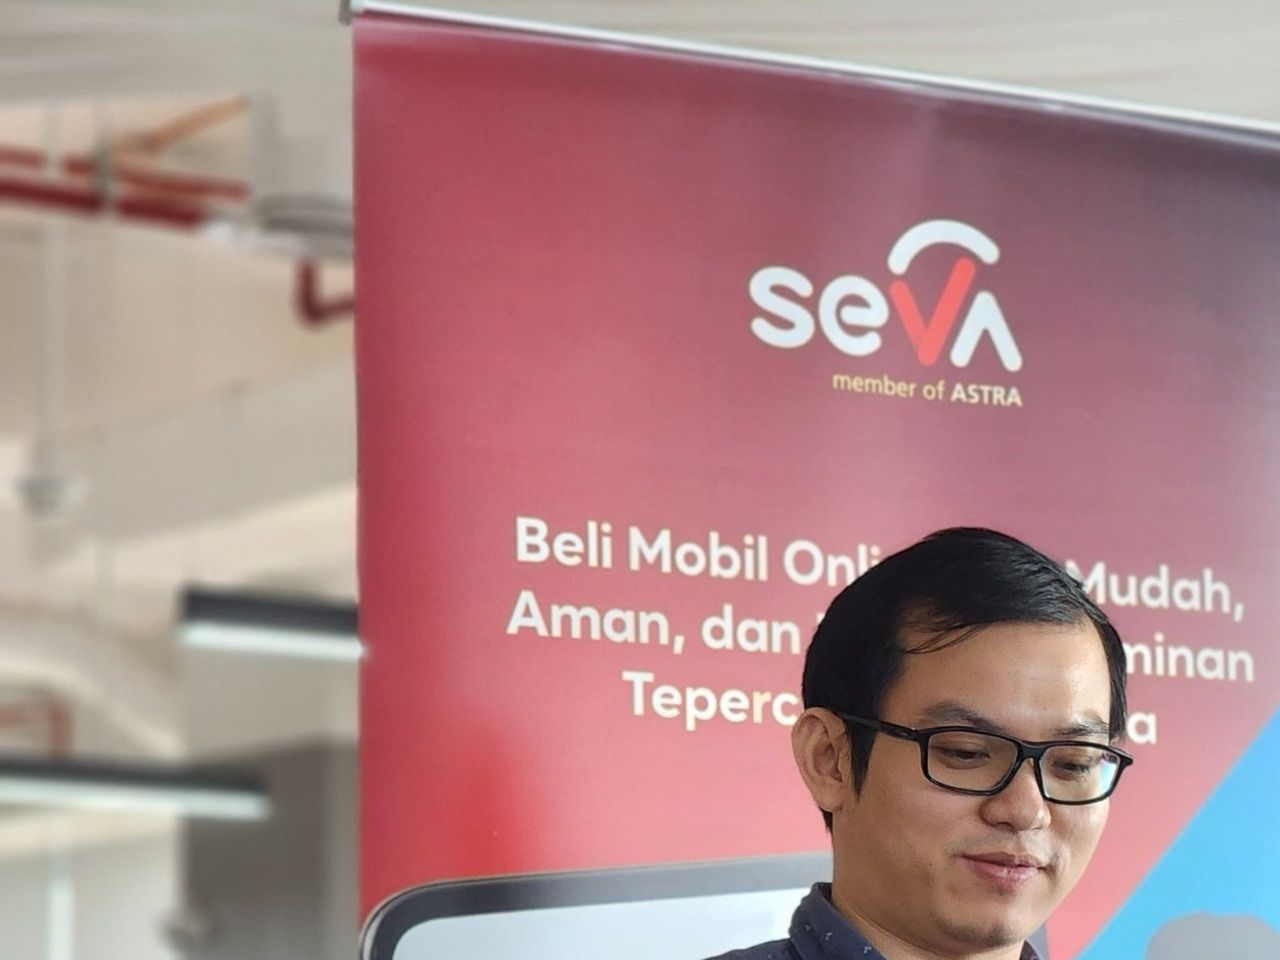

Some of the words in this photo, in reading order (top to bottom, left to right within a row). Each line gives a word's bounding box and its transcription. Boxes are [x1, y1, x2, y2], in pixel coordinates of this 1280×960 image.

[832, 373, 916, 398] member
[922, 380, 946, 401] of
[951, 383, 1023, 407] ASTRA
[515, 516, 613, 568] Beli
[628, 526, 768, 581] Mobil
[783, 539, 880, 587] Onl
[1065, 560, 1244, 622] Mudah,
[506, 589, 685, 654] Aman,
[702, 603, 800, 654] dan
[1122, 632, 1254, 682] minan
[622, 670, 801, 731] Teperc
